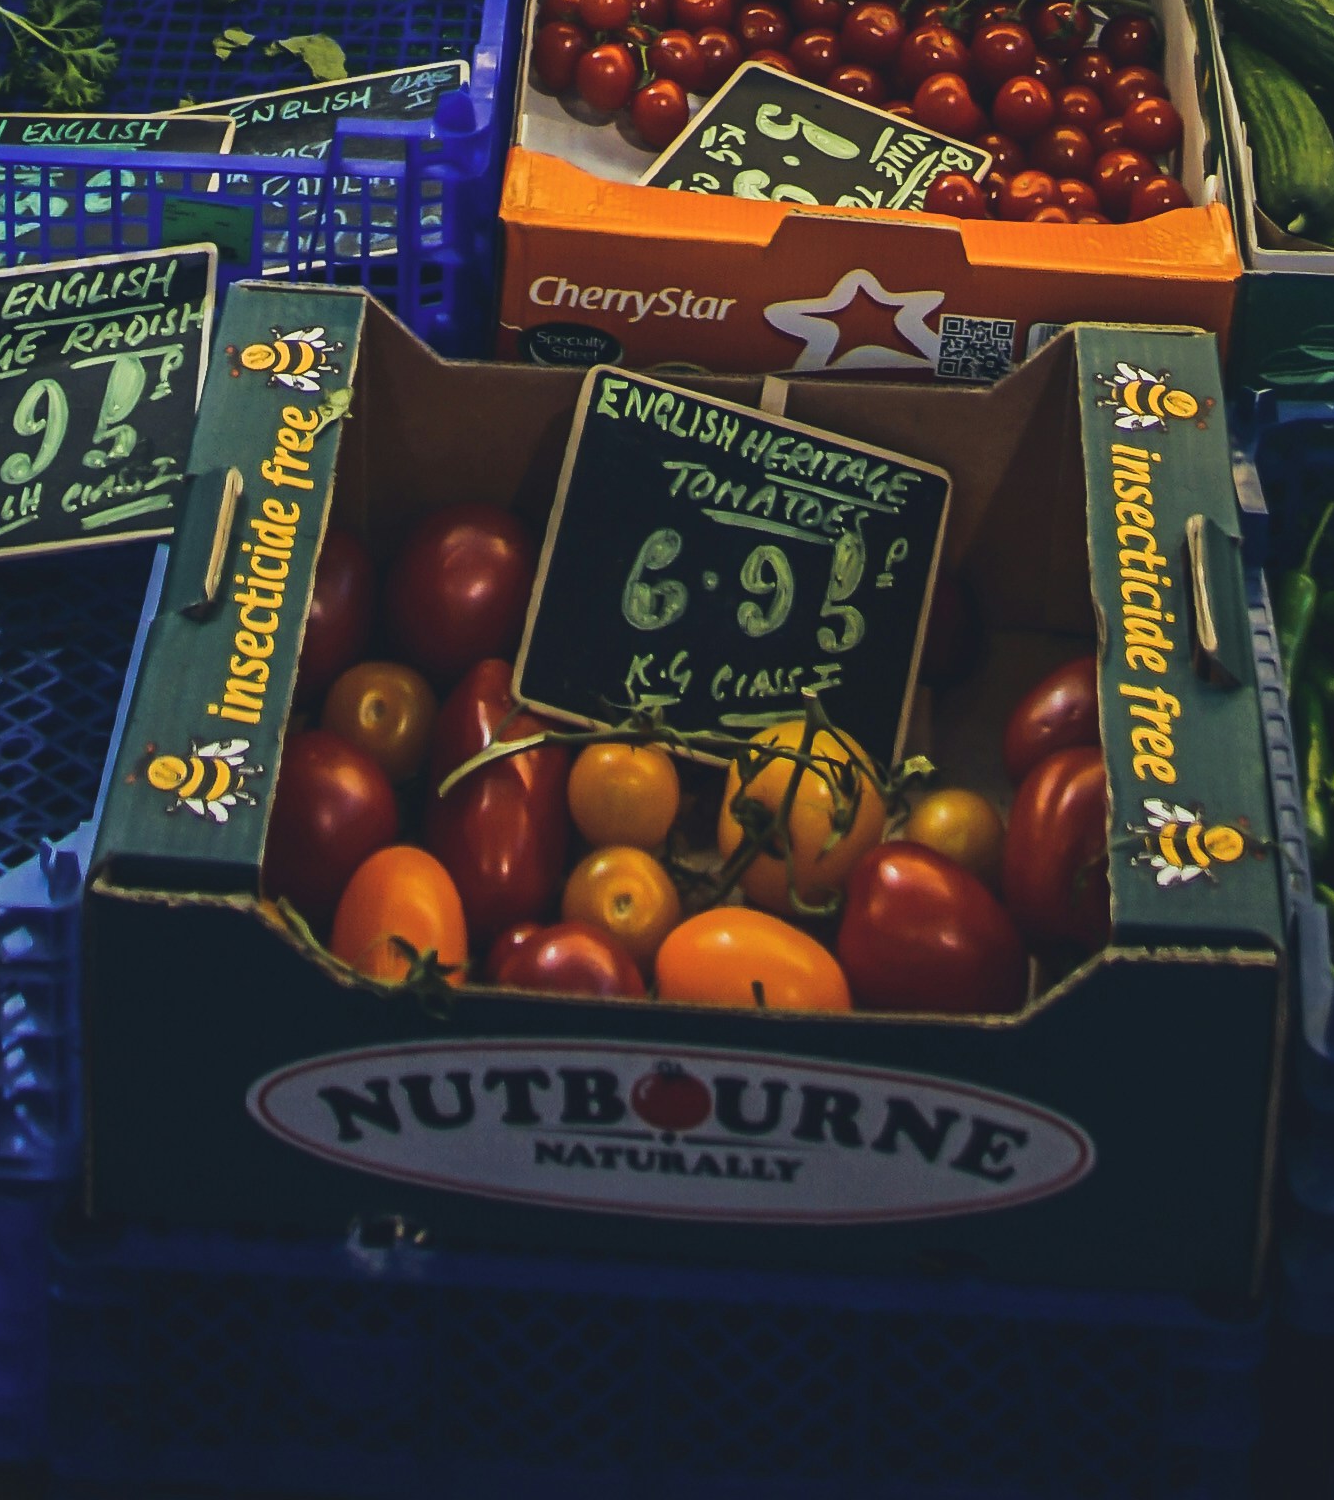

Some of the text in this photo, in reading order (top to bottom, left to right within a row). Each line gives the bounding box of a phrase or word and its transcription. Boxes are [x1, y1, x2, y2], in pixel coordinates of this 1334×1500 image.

[22, 119, 169, 142] ENGLISH
[229, 88, 372, 128] ENGLISH
[2, 260, 179, 320] ENGLISH
[529, 275, 736, 322] CherryStar
[61, 302, 207, 354] RADISH
[535, 329, 608, 353] Specialty
[550, 343, 599, 363] Street
[596, 378, 922, 505] ENGLISH HERITAGE
[663, 461, 869, 536] TOMATOES
[207, 405, 320, 726] insecticide free
[1110, 443, 1183, 786] insecticide free
[533, 1139, 805, 1184] NATURALLY
